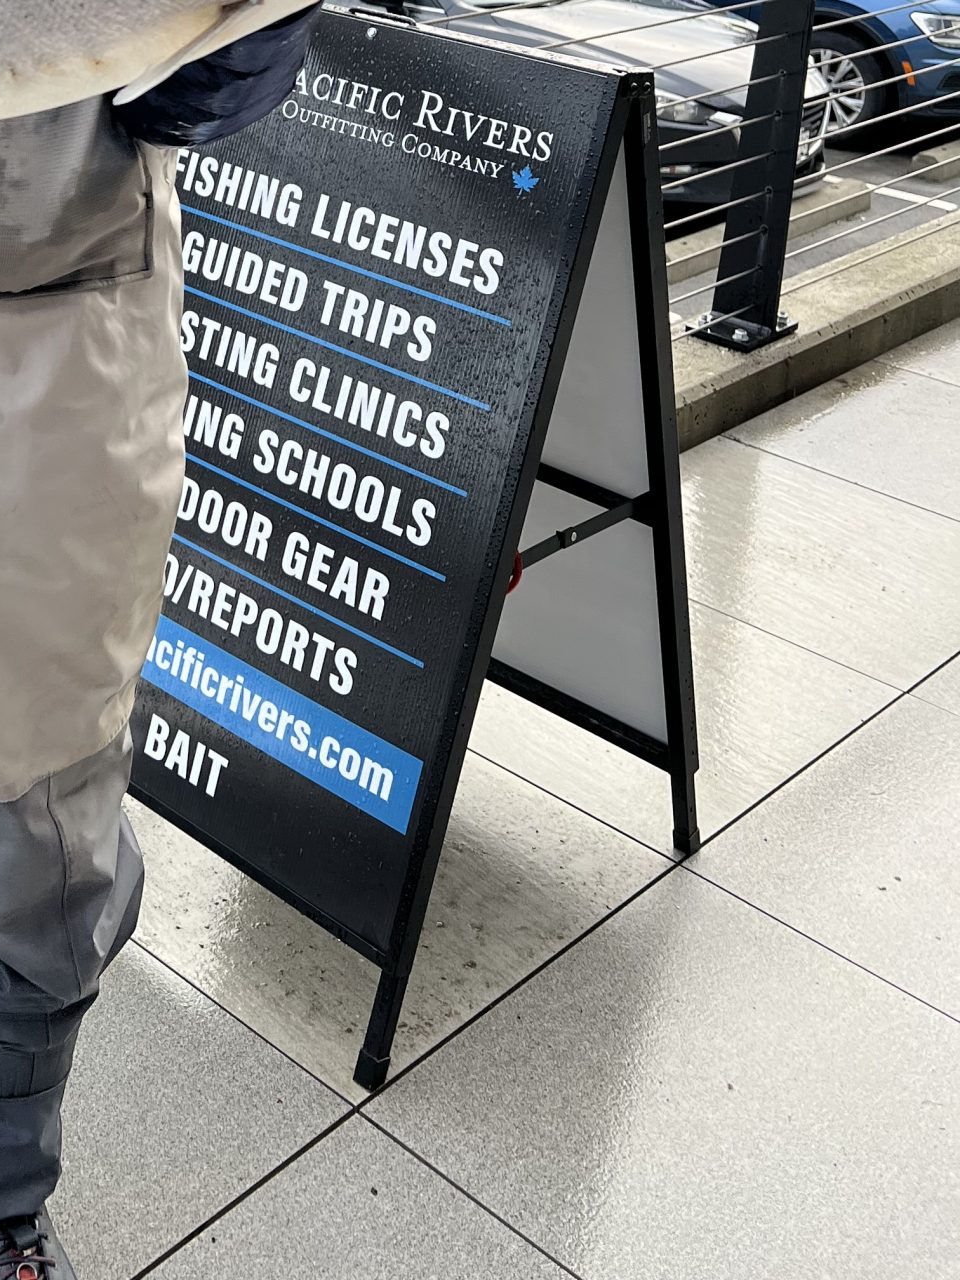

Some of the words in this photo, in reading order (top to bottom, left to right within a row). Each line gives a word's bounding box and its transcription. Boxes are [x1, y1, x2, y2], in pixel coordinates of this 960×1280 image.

[282, 99, 395, 148] OUTFITTING
[401, 132, 505, 179] COMPANY
[292, 68, 404, 120] ACIFIC
[412, 89, 554, 161] RIVERS
[182, 230, 309, 312] GUIDED
[321, 279, 437, 362] TRIPS
[311, 193, 504, 295] LICENSES
[180, 310, 280, 389] STING
[290, 357, 450, 459] CLINICS
[184, 394, 245, 460] ING
[252, 429, 436, 547] SCHOOLS
[177, 475, 273, 562] DOOR
[281, 531, 390, 621] GEAR
[163, 552, 358, 695] O/REPORTS
[143, 713, 229, 797] BAIT
[146, 634, 394, 802] cificrivers.com
